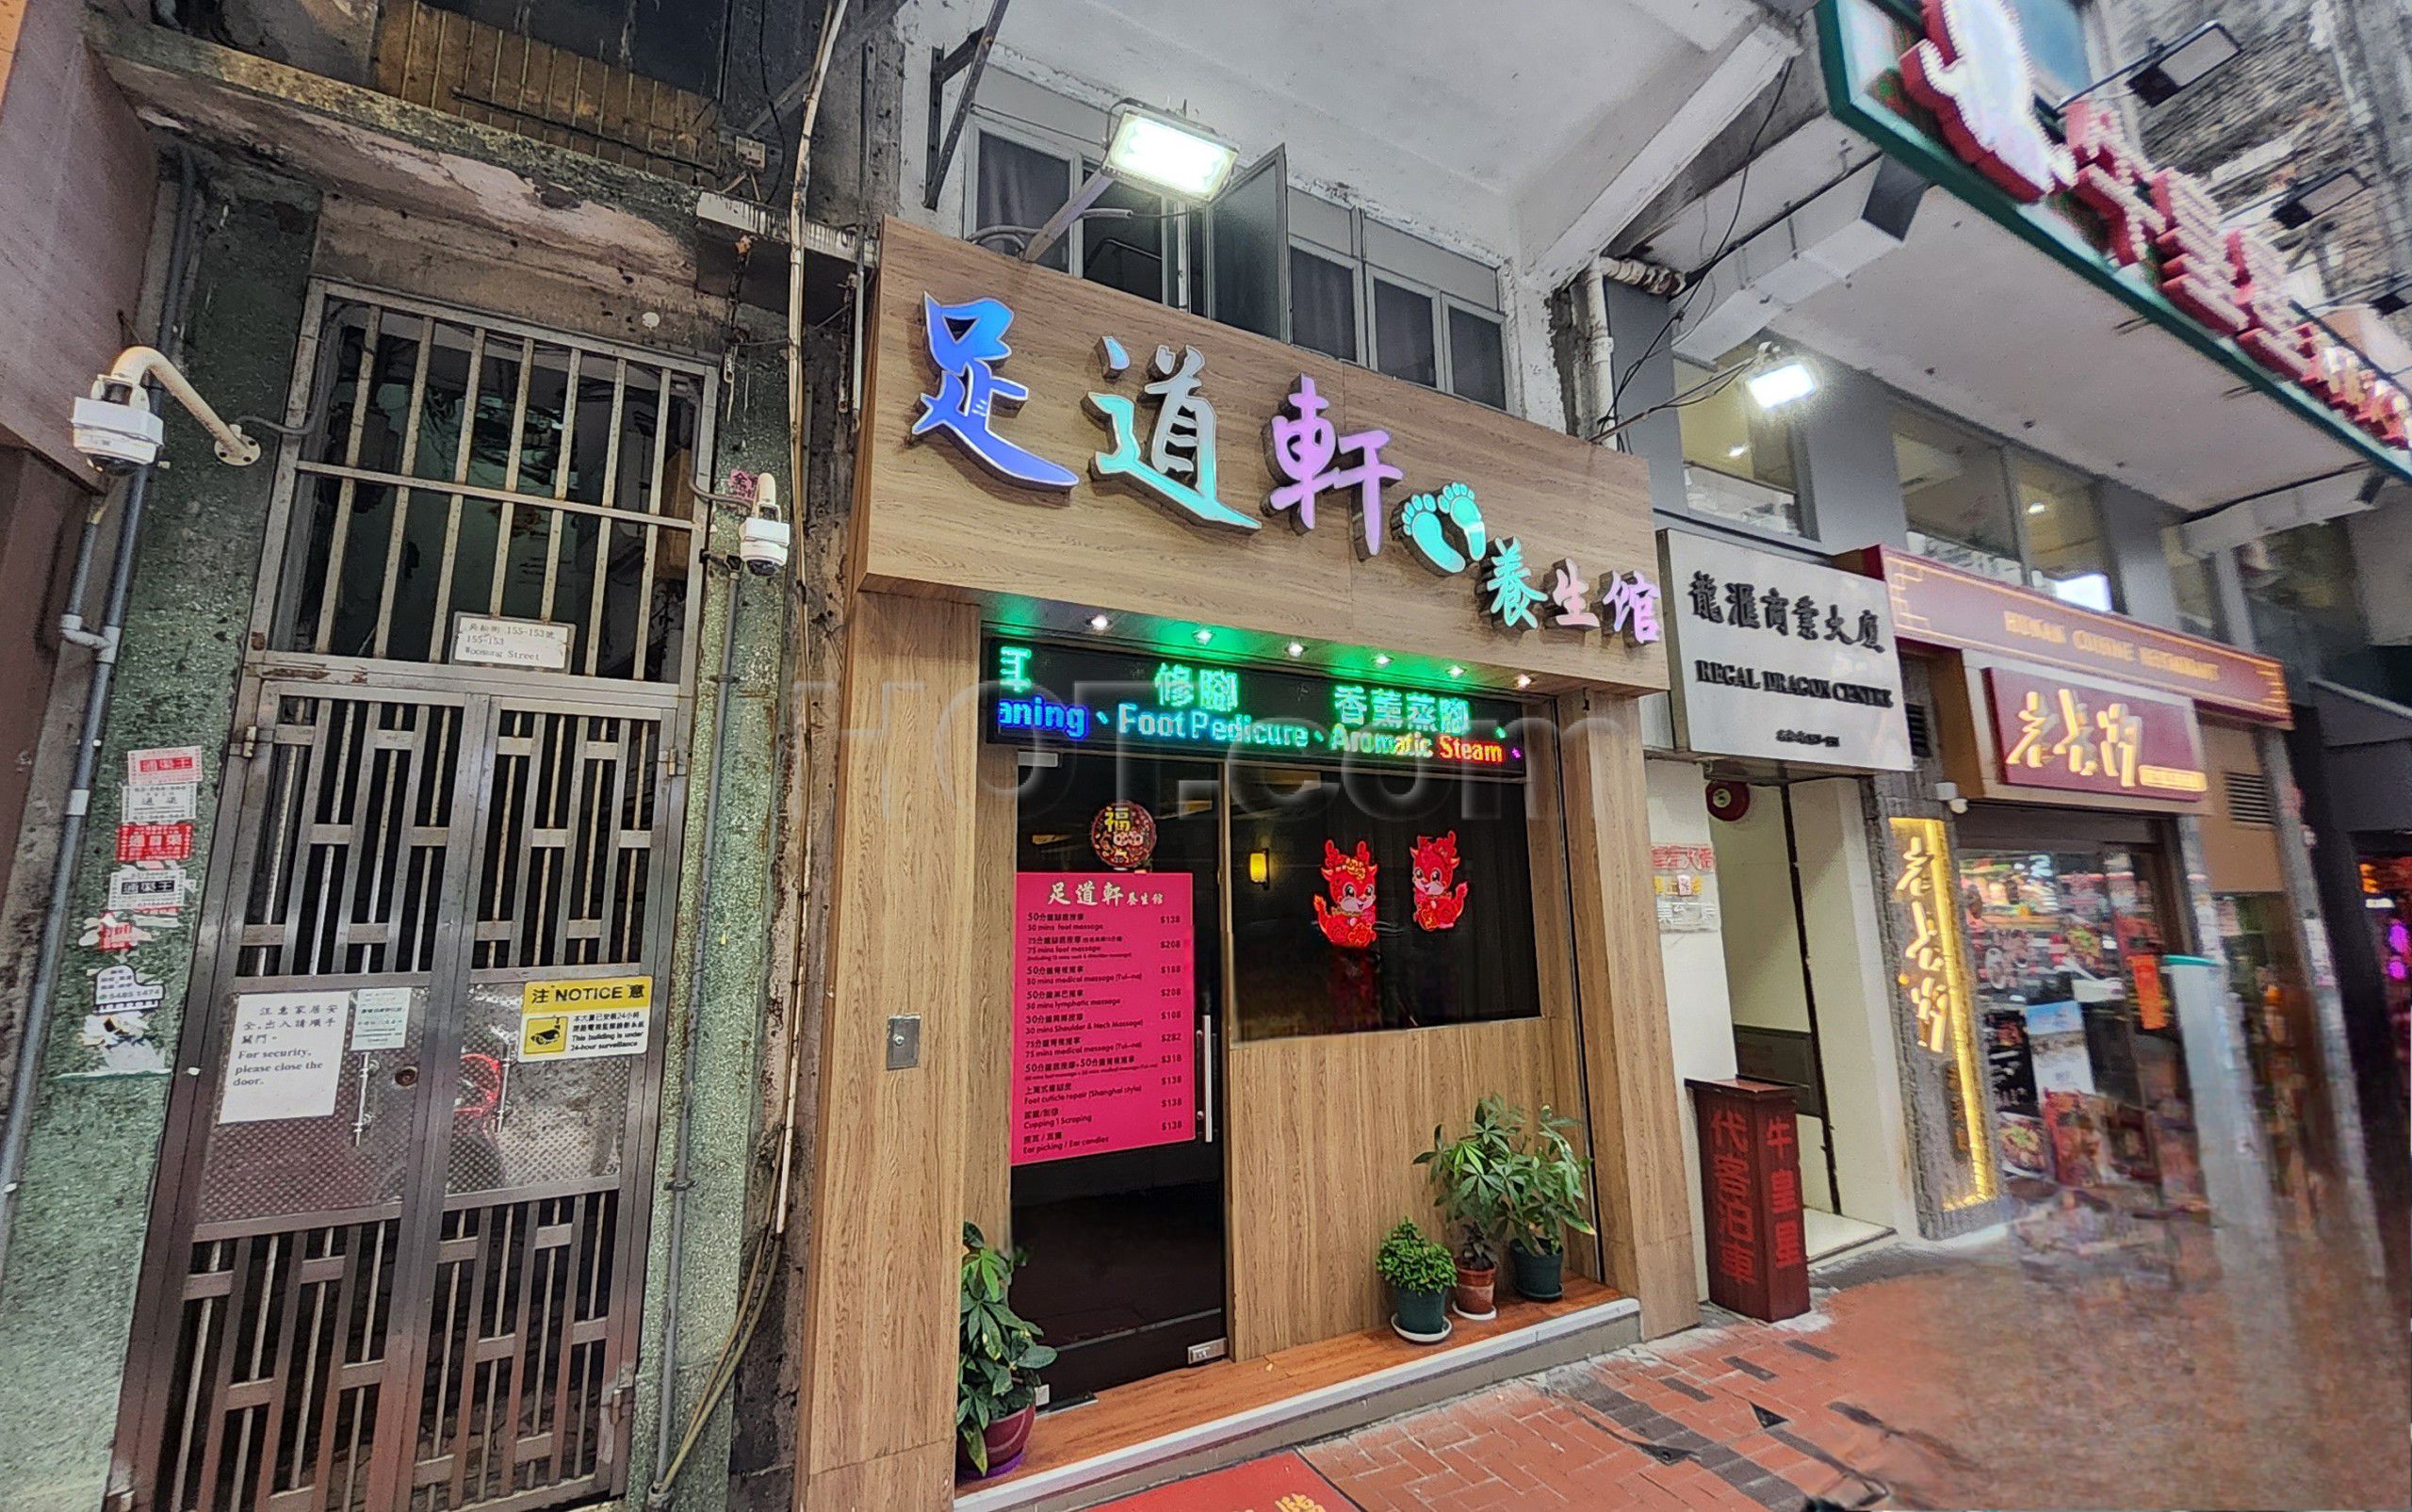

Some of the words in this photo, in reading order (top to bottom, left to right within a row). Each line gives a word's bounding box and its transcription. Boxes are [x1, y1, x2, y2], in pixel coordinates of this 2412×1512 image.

[911, 290, 1404, 556] 足道軒
[508, 650, 540, 660] Street
[1695, 659, 1761, 690] REGAL
[1762, 671, 1832, 699] DRAGON
[1832, 682, 1894, 708] CENTRE
[1117, 703, 1186, 739] Foot
[1191, 710, 1309, 749] Pedicure
[1329, 723, 1434, 758] Aromatic
[1438, 733, 1506, 764] Steam
[1104, 805, 1132, 833] 福
[1047, 880, 1124, 907] 足道軒
[555, 985, 624, 1002] NOTICE
[1055, 1000, 1089, 1009] lymphatic
[1036, 1025, 1053, 1033] mins
[1054, 1023, 1085, 1032] Shoulder
[588, 1032, 615, 1041] building
[570, 1043, 597, 1051] 24-hour
[598, 1041, 638, 1049] surveillance
[1054, 1047, 1083, 1055] medical
[1084, 1045, 1114, 1053] massage
[237, 1049, 260, 1060] For
[235, 1064, 272, 1077] please
[274, 1062, 303, 1072] close
[305, 1060, 324, 1070] the
[233, 1078, 265, 1087] door.
[1041, 1094, 1065, 1103] cuticle
[1066, 1091, 1087, 1100] repair
[1023, 1119, 1055, 1130] Cupping
[1061, 1114, 1093, 1124] Scraping
[1036, 1142, 1063, 1154] picking
[1068, 1139, 1081, 1147] Ear
